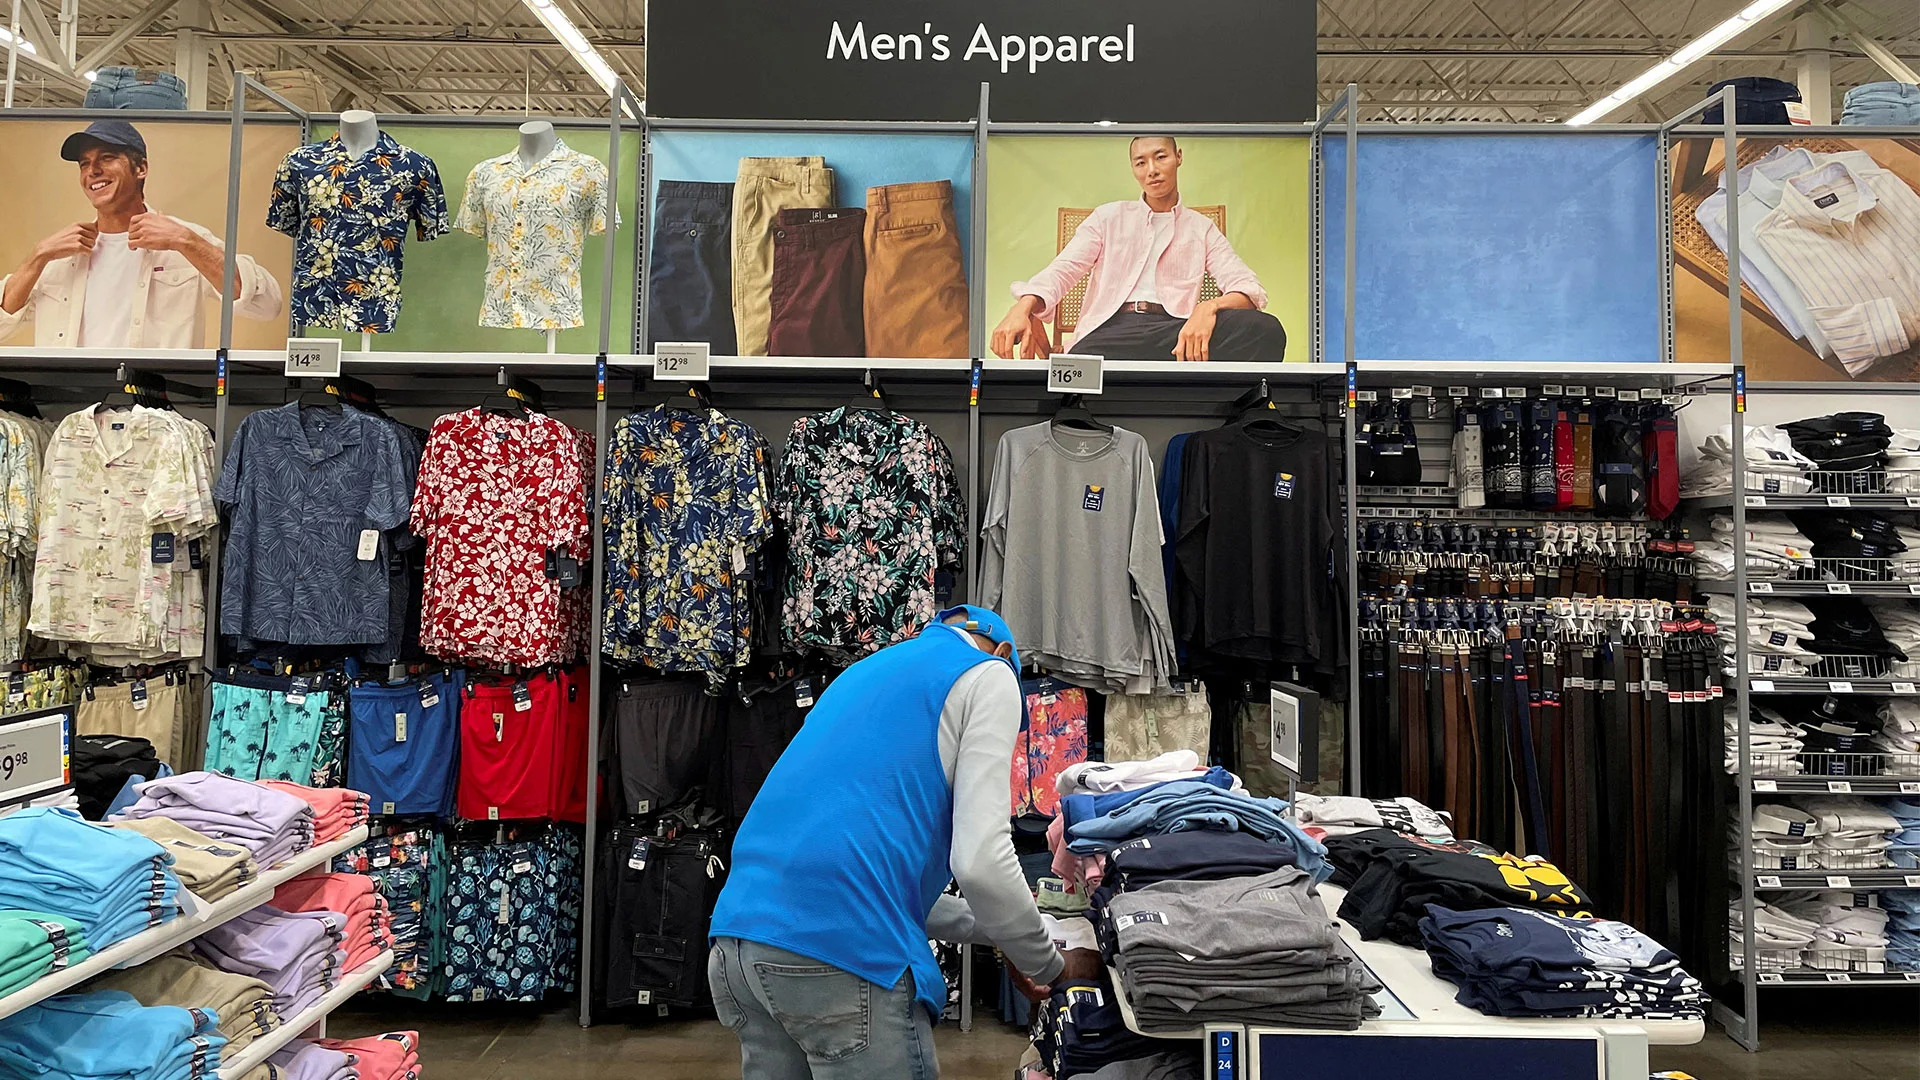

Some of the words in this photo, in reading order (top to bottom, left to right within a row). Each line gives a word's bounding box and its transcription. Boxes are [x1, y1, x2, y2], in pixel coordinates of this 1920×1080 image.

[826, 20, 950, 61] Men's
[963, 22, 1134, 74] Apparel
[1221, 1037, 1230, 1047] D
[1218, 1060, 1231, 1070] 24
